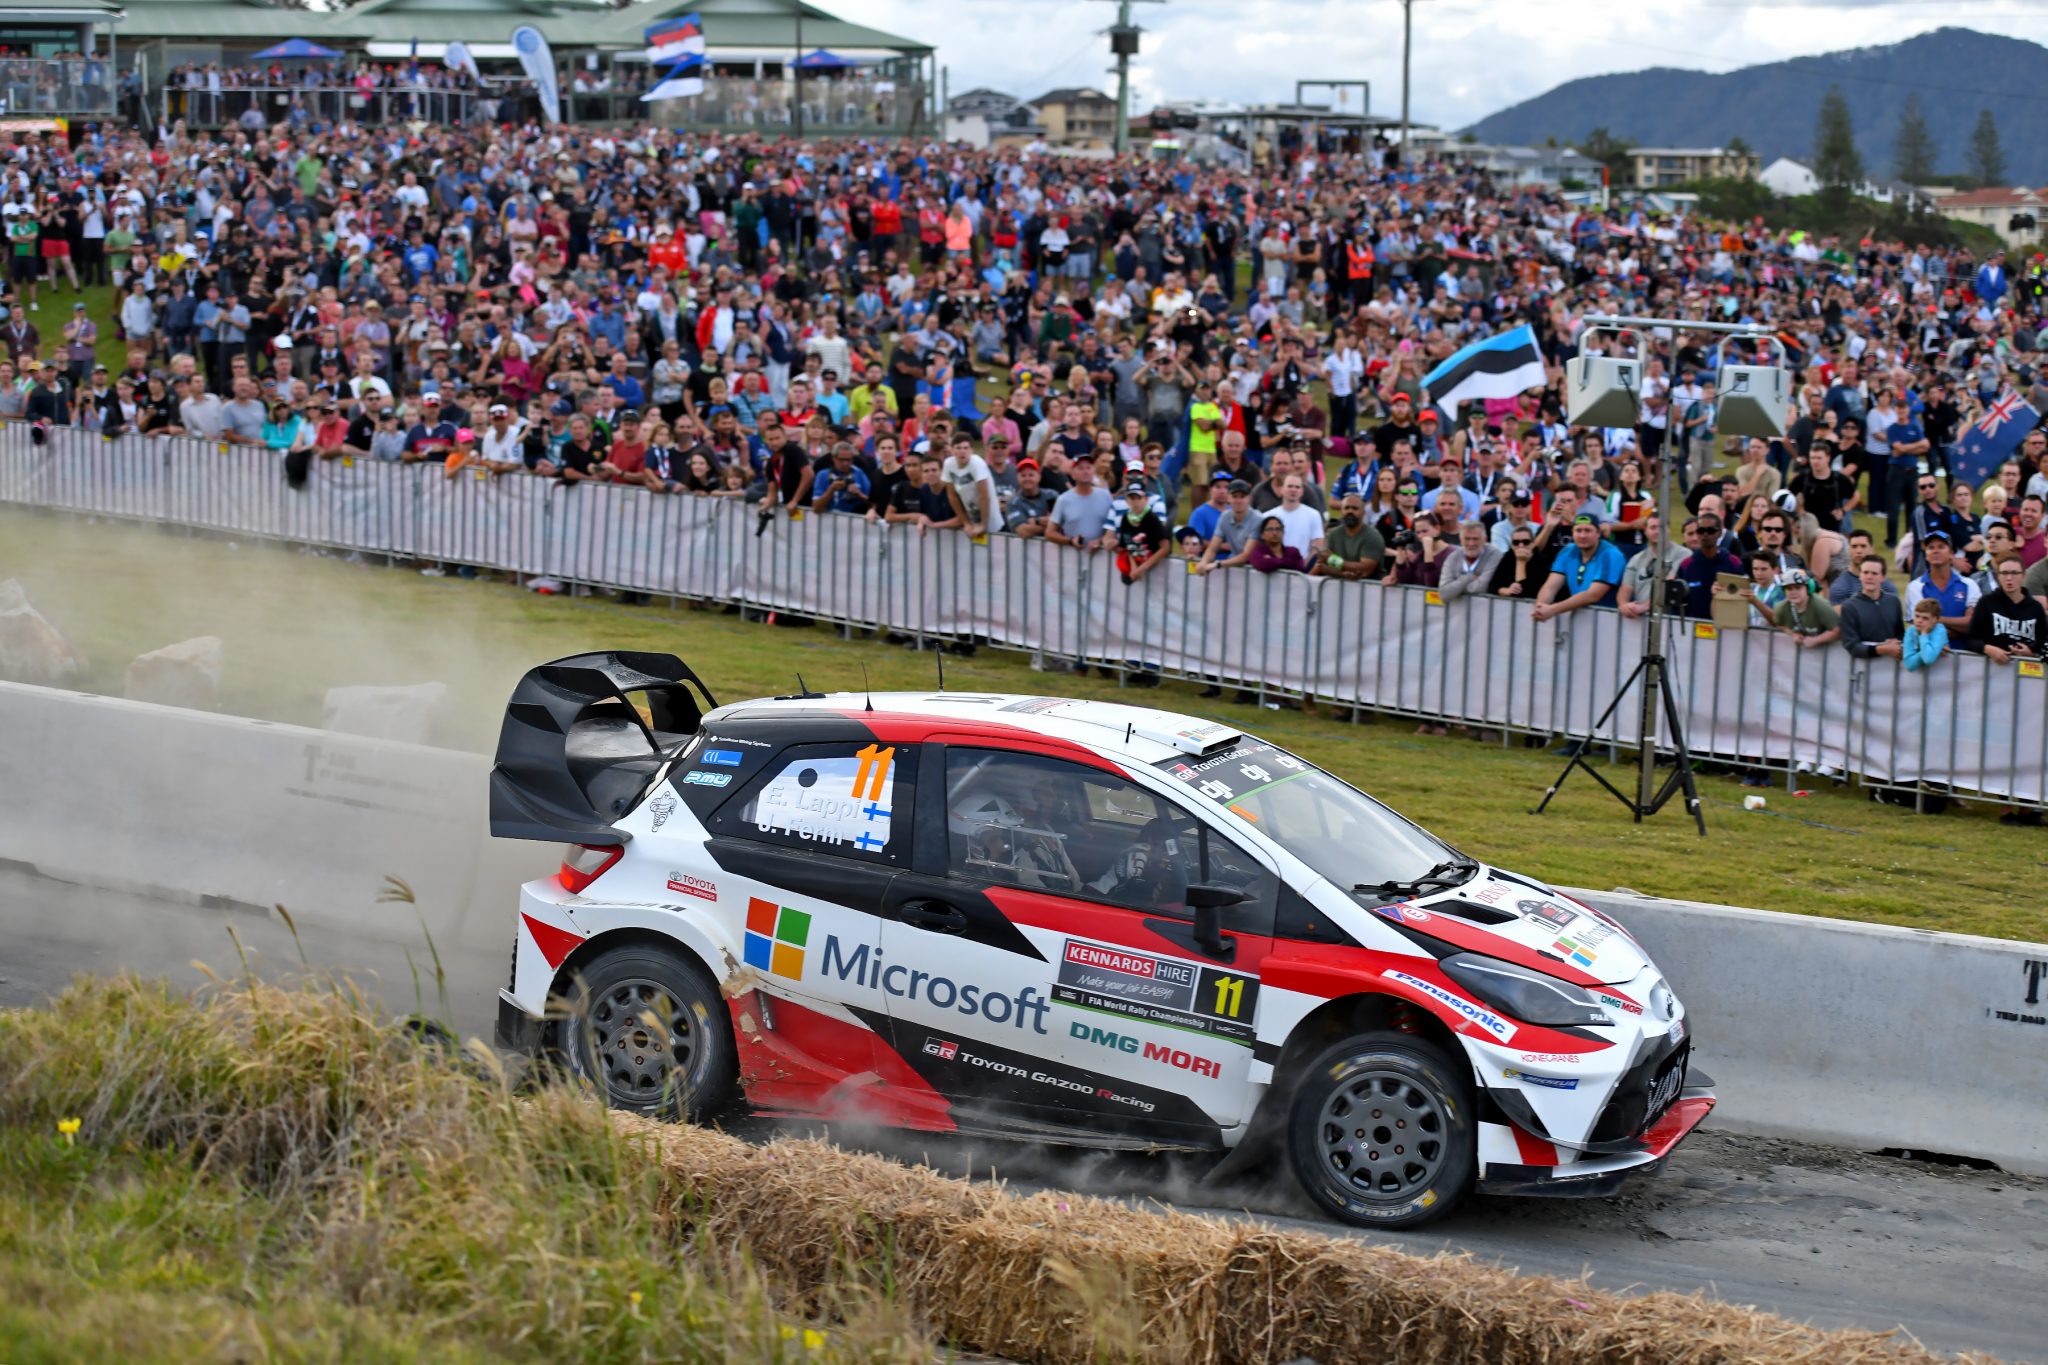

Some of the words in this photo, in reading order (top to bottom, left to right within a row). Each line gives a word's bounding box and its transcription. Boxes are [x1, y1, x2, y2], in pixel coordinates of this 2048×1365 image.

[851, 743, 896, 802] 11
[1192, 755, 1228, 772] TOYOTA
[767, 787, 787, 807] E.
[796, 790, 862, 821] Lappi
[785, 819, 844, 845] Ferm
[669, 882, 693, 893] FINANCIAL
[693, 889, 716, 900] SERVICES
[683, 875, 716, 891] TOYOTA
[1475, 884, 1512, 904] DENSO
[1070, 946, 1151, 974] KENNARDS
[1156, 966, 1190, 982] HIRE
[821, 934, 1050, 1034] Microsoft
[1077, 975, 1103, 988] Make
[1104, 980, 1128, 991] your
[1120, 983, 1140, 994] job
[1215, 976, 1244, 1018] 11
[1088, 996, 1102, 1006] FIA
[1104, 1000, 1127, 1012] World
[1128, 1005, 1149, 1017] Rally
[1149, 1009, 1206, 1028] Championship
[1395, 972, 1506, 1034] Panasonic
[1601, 995, 1622, 1009] DMG
[1621, 1002, 1644, 1016] MORI
[1070, 1022, 1139, 1054] DMG
[1143, 1042, 1222, 1080] MORI
[1521, 1054, 1581, 1064] KONECRANES
[926, 1041, 955, 1058] GR
[961, 1052, 1028, 1078] TOYOTA
[1031, 1071, 1094, 1095] GAZOO
[1097, 1088, 1156, 1113] Racing
[1526, 1074, 1578, 1088] MICHELIN
